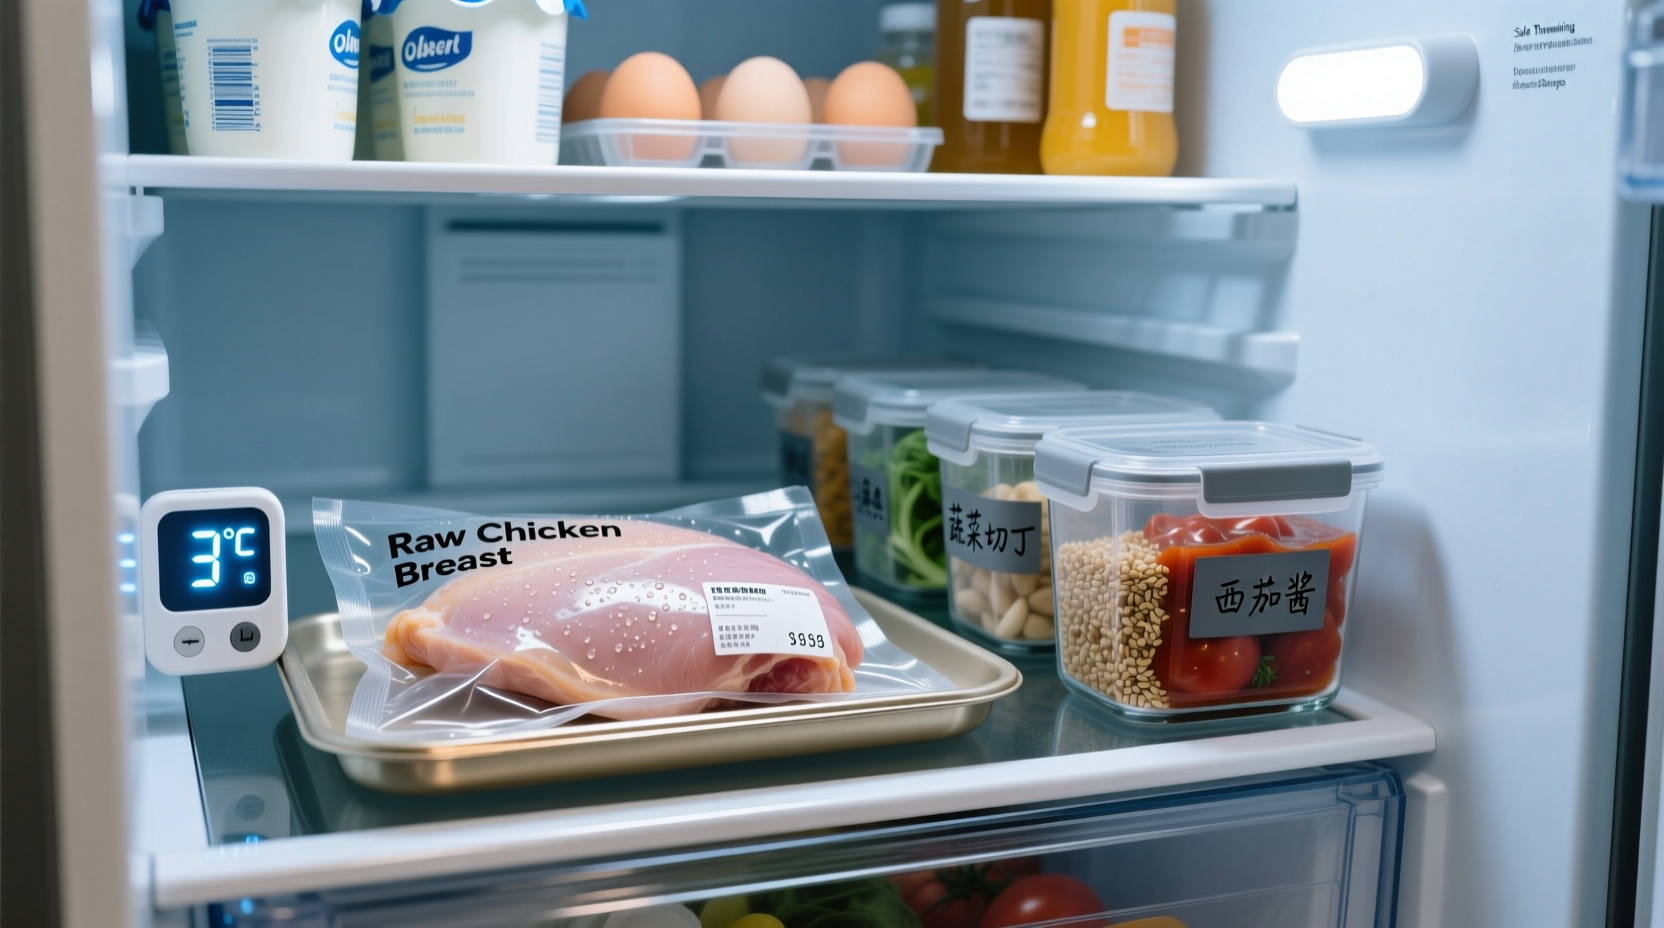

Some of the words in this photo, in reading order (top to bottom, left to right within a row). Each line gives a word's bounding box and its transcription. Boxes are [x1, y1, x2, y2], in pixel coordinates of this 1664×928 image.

[387, 529, 466, 559] Raw
[476, 520, 622, 543] Chicken
[948, 502, 1036, 557] 蔬菜切丁
[394, 547, 513, 588] Breast
[1214, 570, 1316, 618] 西茄酱
